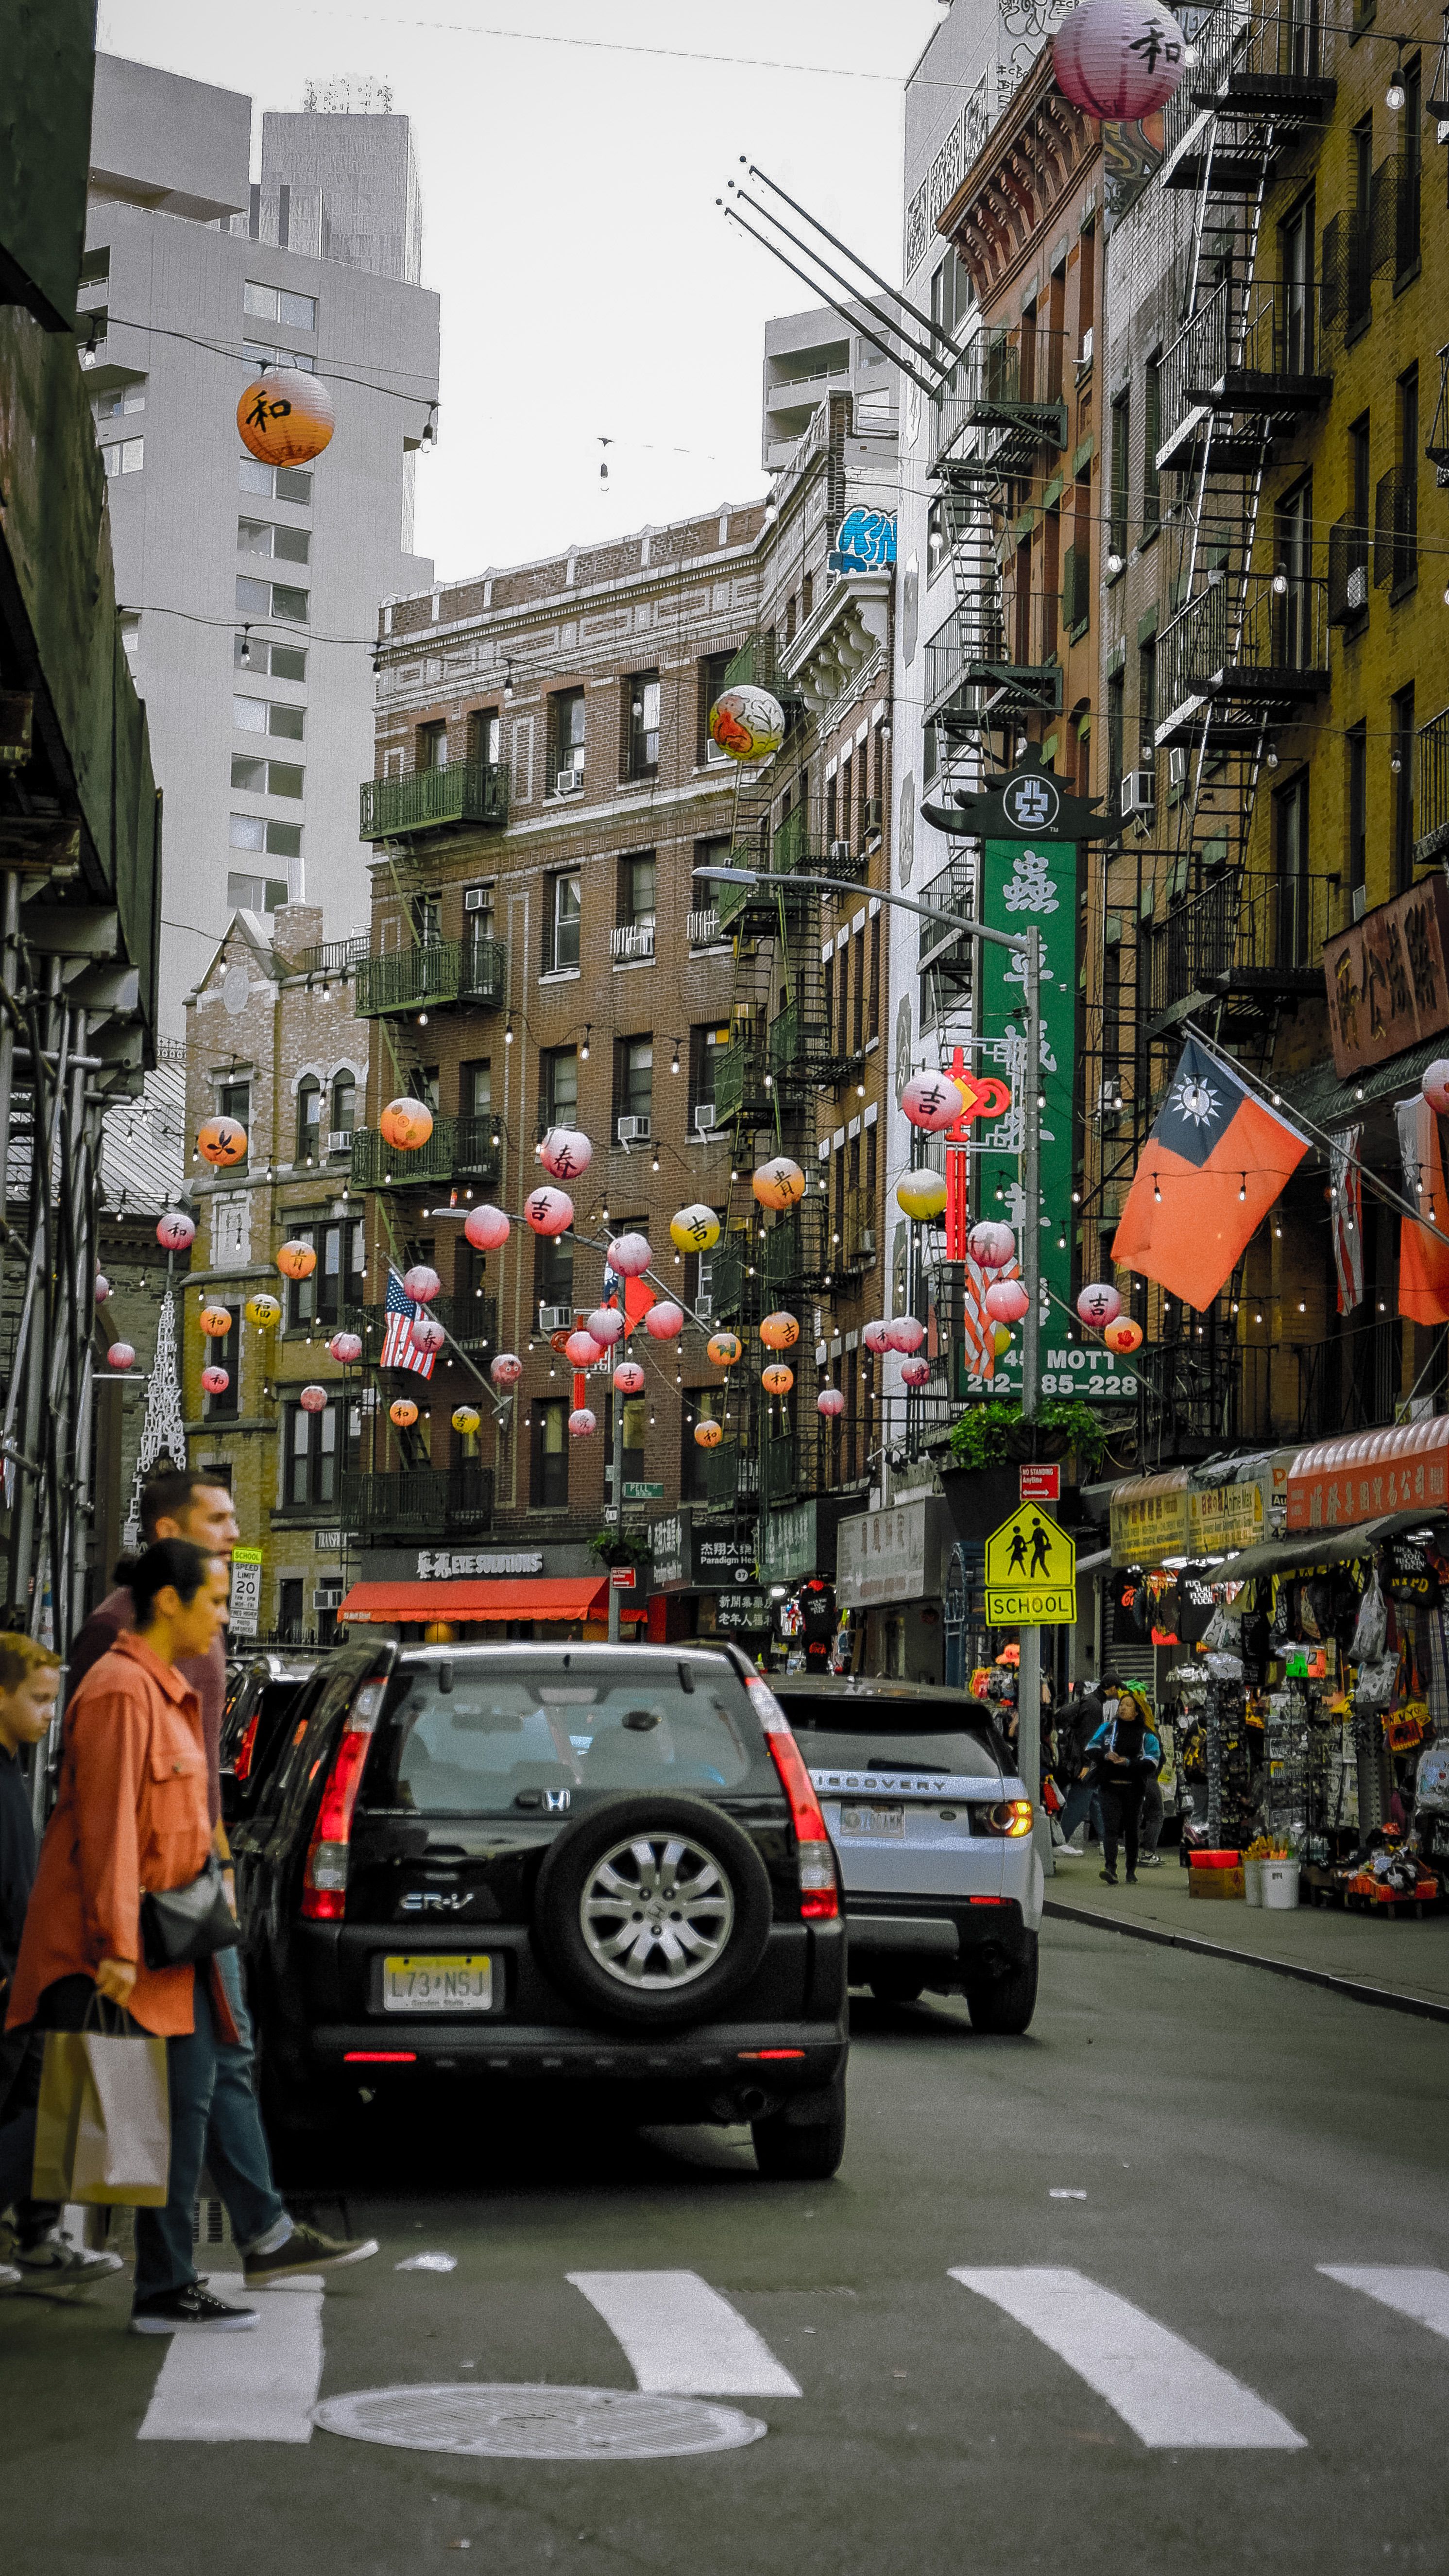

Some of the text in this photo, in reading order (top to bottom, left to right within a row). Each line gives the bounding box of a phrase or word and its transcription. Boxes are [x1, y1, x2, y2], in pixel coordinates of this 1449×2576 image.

[1128, 17, 1182, 74] 和
[244, 390, 291, 432] 和
[920, 1084, 946, 1115] 吉
[553, 1144, 577, 1179] 春
[531, 1195, 552, 1221] 吉
[167, 1222, 187, 1238] 和
[687, 1215, 708, 1242] 吉
[254, 1299, 271, 1318] 福
[1089, 1293, 1108, 1316] 吉
[207, 1314, 223, 1328] 和
[423, 1328, 437, 1354] 春
[782, 1322, 795, 1343] 吉
[1047, 1350, 1114, 1370] MOTT
[210, 1374, 224, 1386] 和
[623, 1369, 637, 1386] 吉
[770, 1371, 787, 1386] 和
[967, 1373, 1138, 1395] 212-85-228
[394, 1407, 409, 1419] 和
[456, 1413, 468, 1427] 吉
[703, 1429, 717, 1442] 和
[1030, 1468, 1054, 1476] STANDING
[630, 1484, 649, 1493] PELL
[235, 1552, 260, 1561] SCHOOL
[451, 1555, 477, 1574] EYE
[476, 1552, 543, 1573] SOLUTIONS
[700, 1556, 739, 1566] Paradigm
[235, 1563, 258, 1572] SPEED
[236, 1580, 255, 1595] 20
[994, 1597, 1069, 1614] SCHOOL
[818, 1777, 946, 1791] ISCOVERY
[399, 1893, 475, 1911] CR-V
